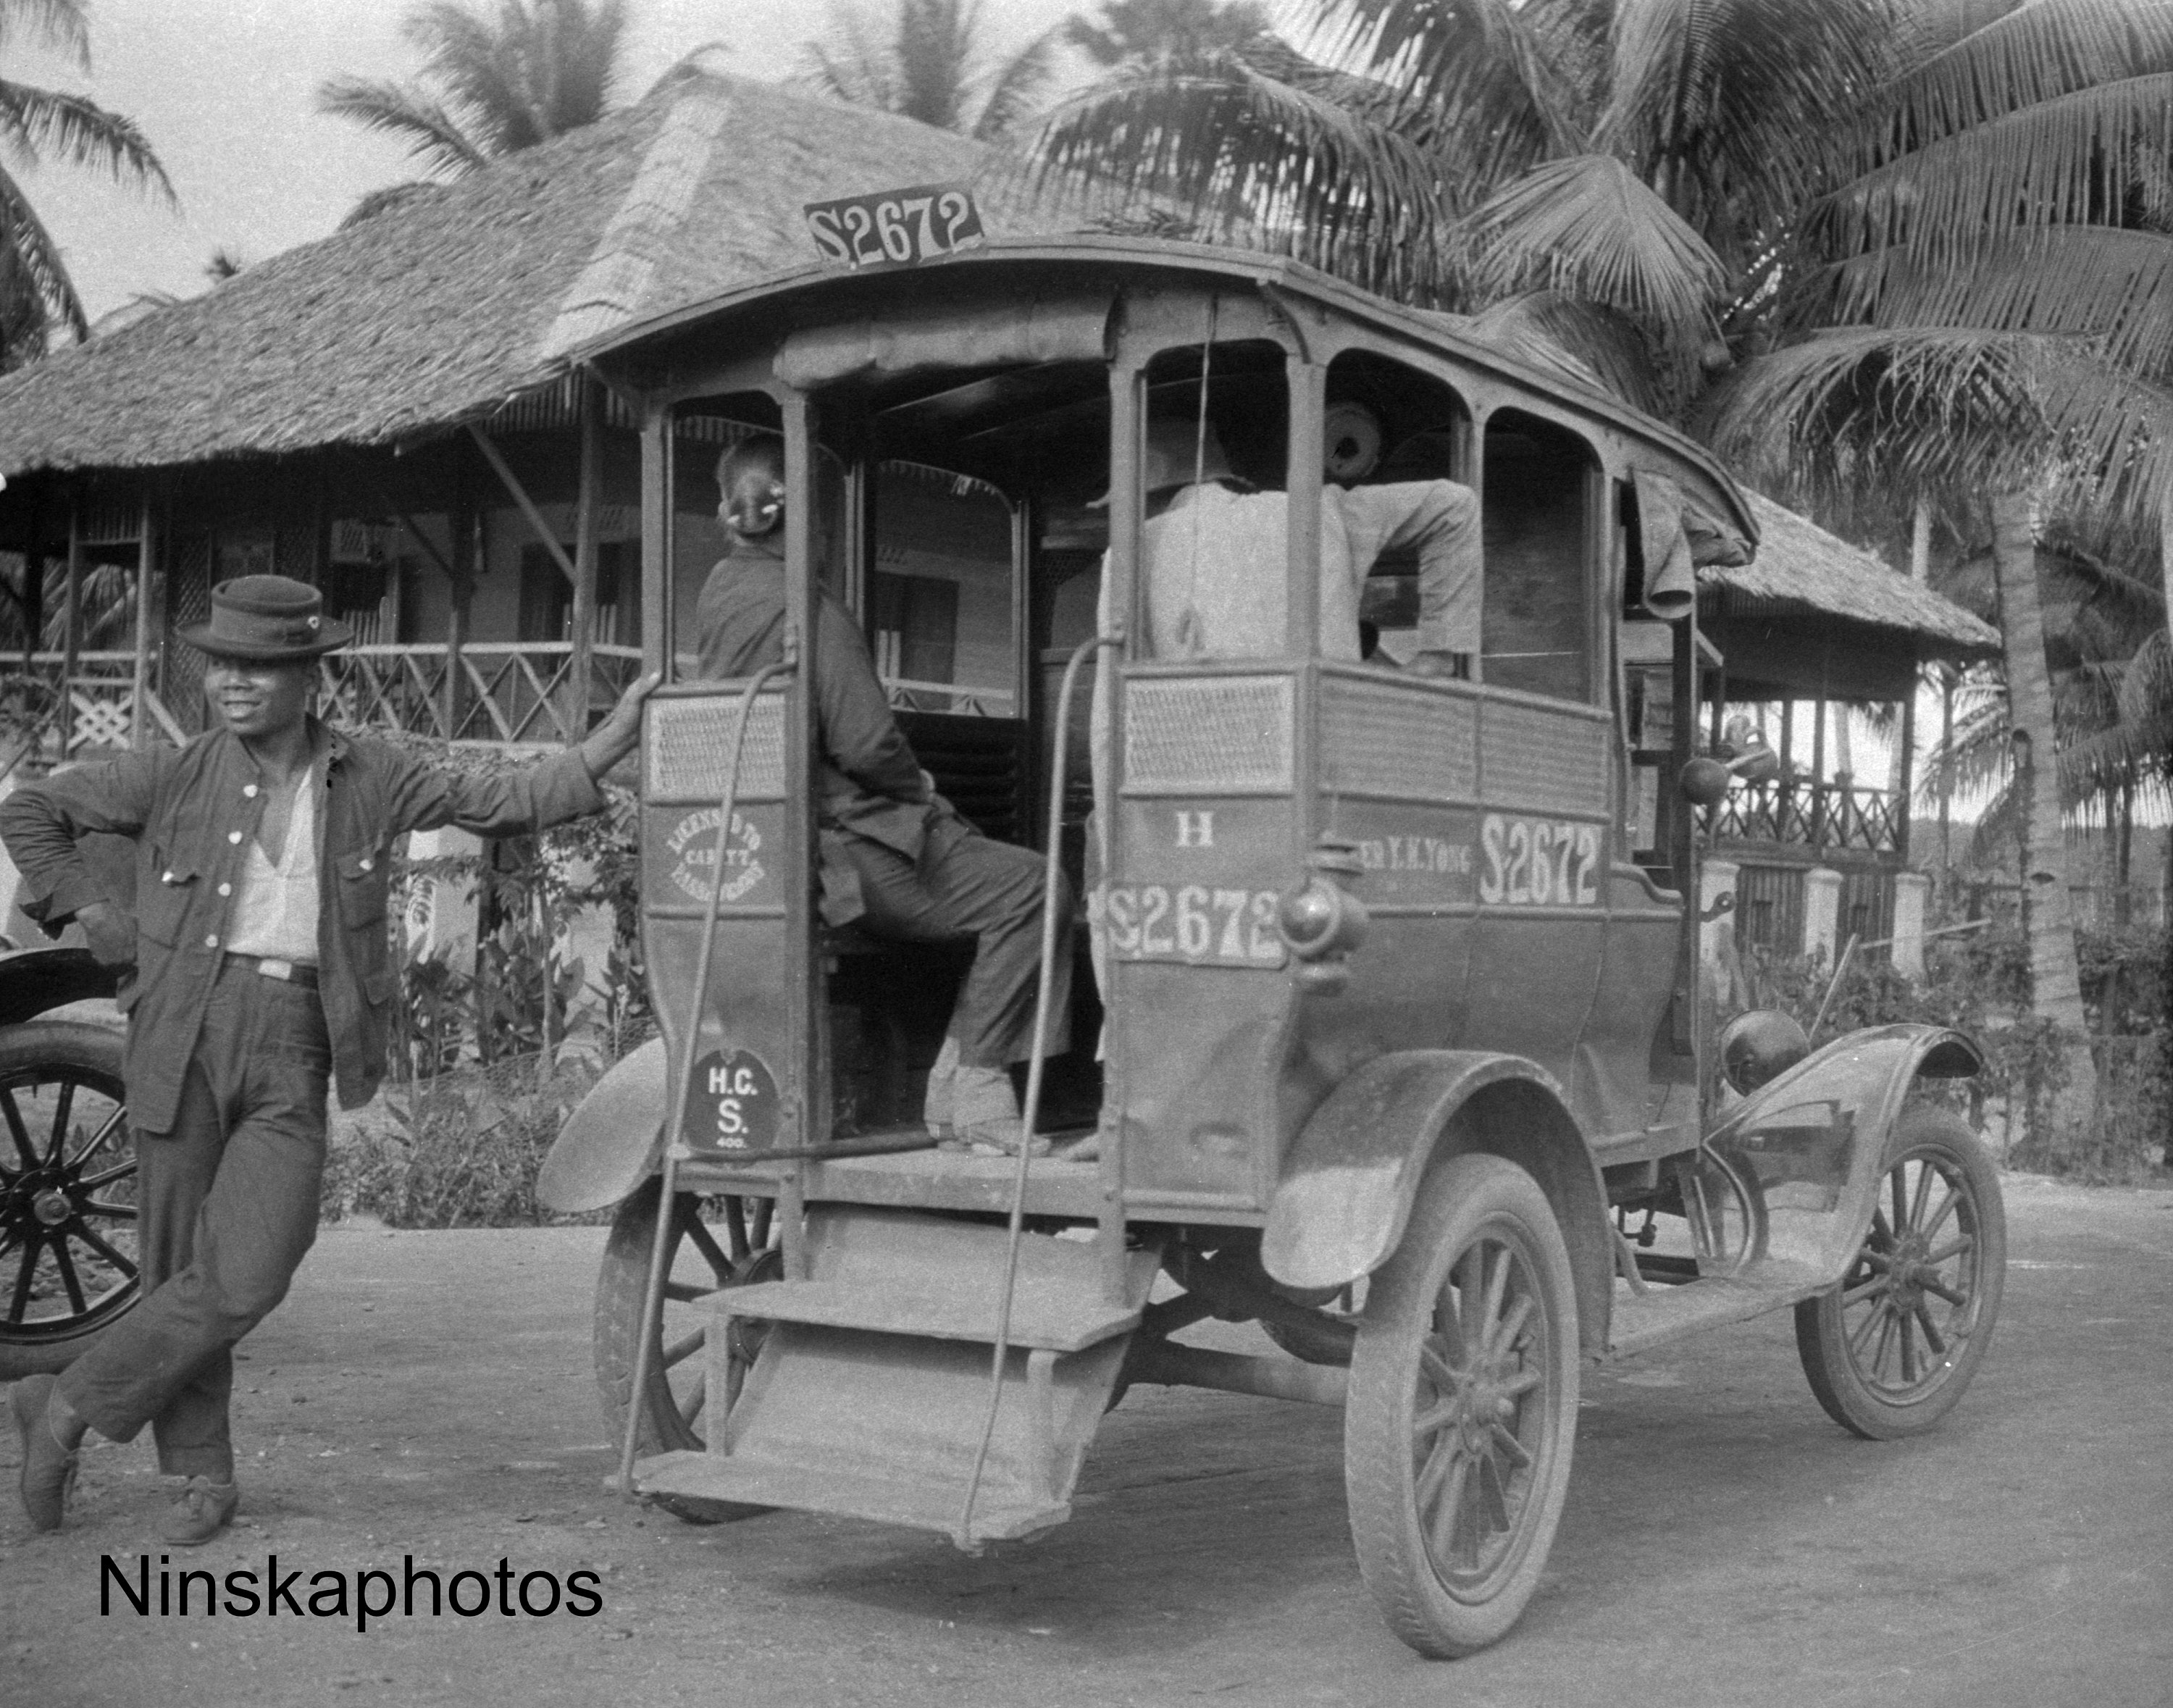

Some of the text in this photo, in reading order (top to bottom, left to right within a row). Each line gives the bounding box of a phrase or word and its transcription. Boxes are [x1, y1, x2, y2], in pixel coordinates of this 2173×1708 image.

[666, 808, 761, 855] LICENSD TO
[1176, 811, 1214, 848] H
[684, 848, 737, 866] CARY
